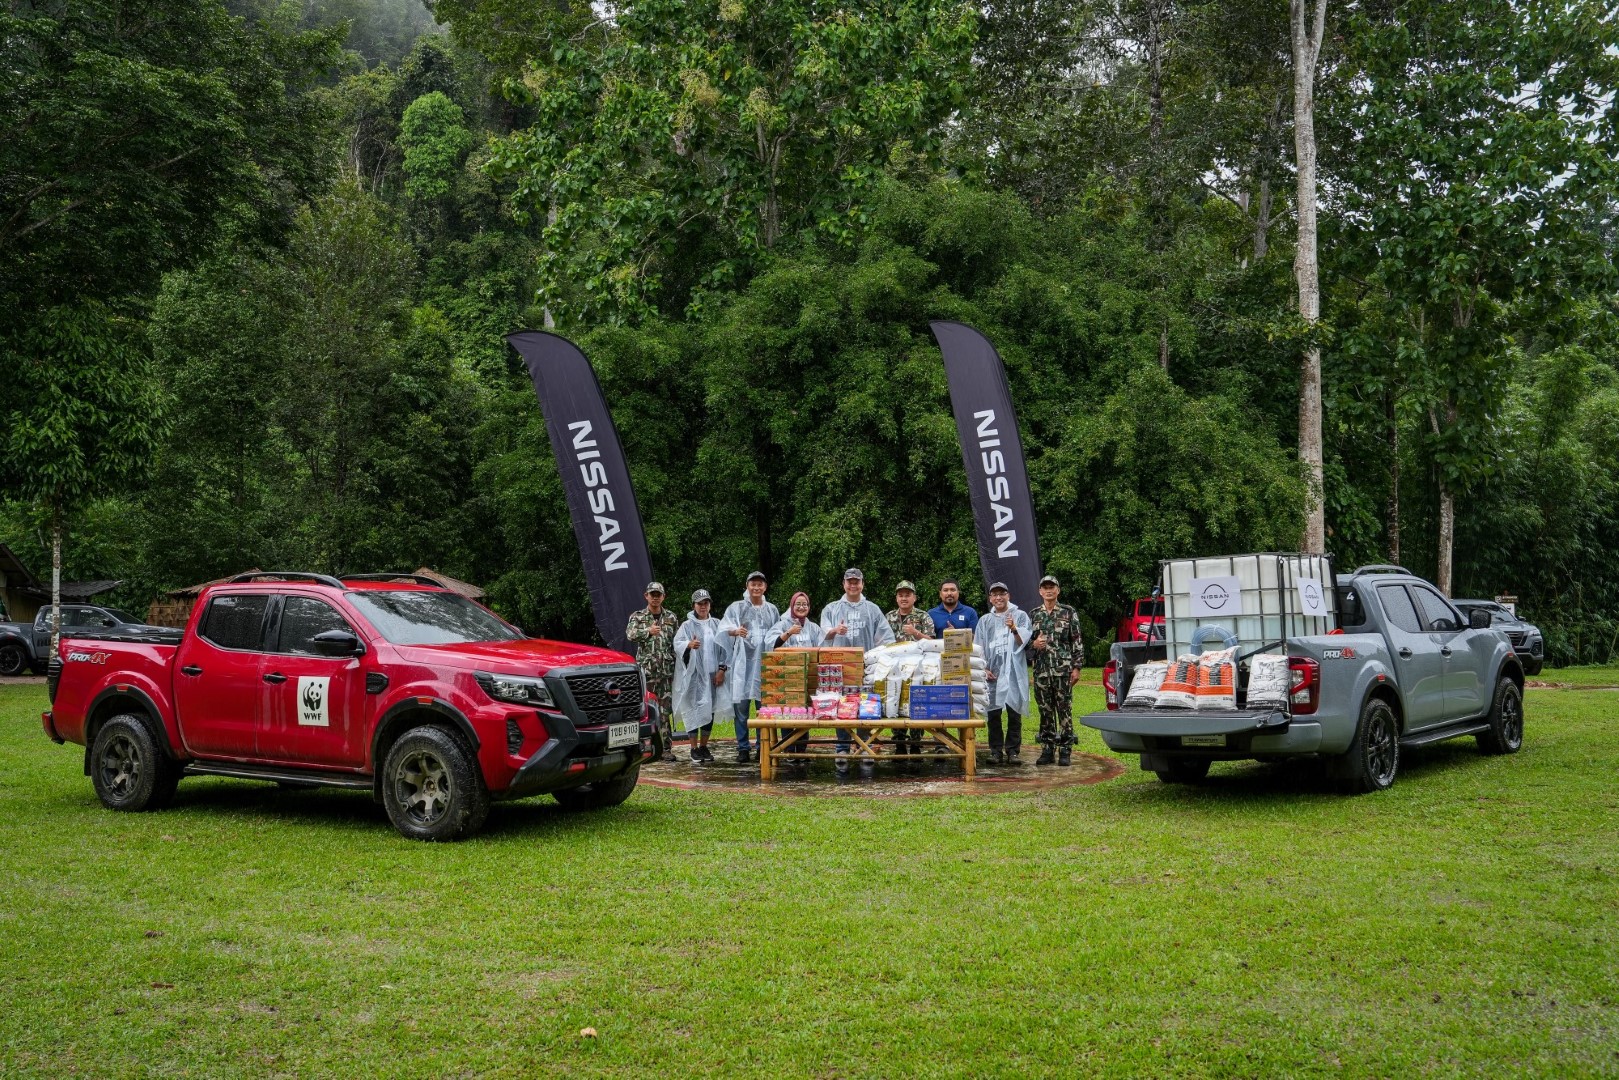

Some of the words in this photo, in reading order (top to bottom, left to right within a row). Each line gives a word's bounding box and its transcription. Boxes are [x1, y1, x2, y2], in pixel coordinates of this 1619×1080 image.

[973, 409, 1019, 559] NISSAN
[567, 420, 629, 572] NISSAN
[1346, 592, 1355, 600] 4
[303, 712, 322, 720] WWF
[623, 724, 638, 735] 9103
